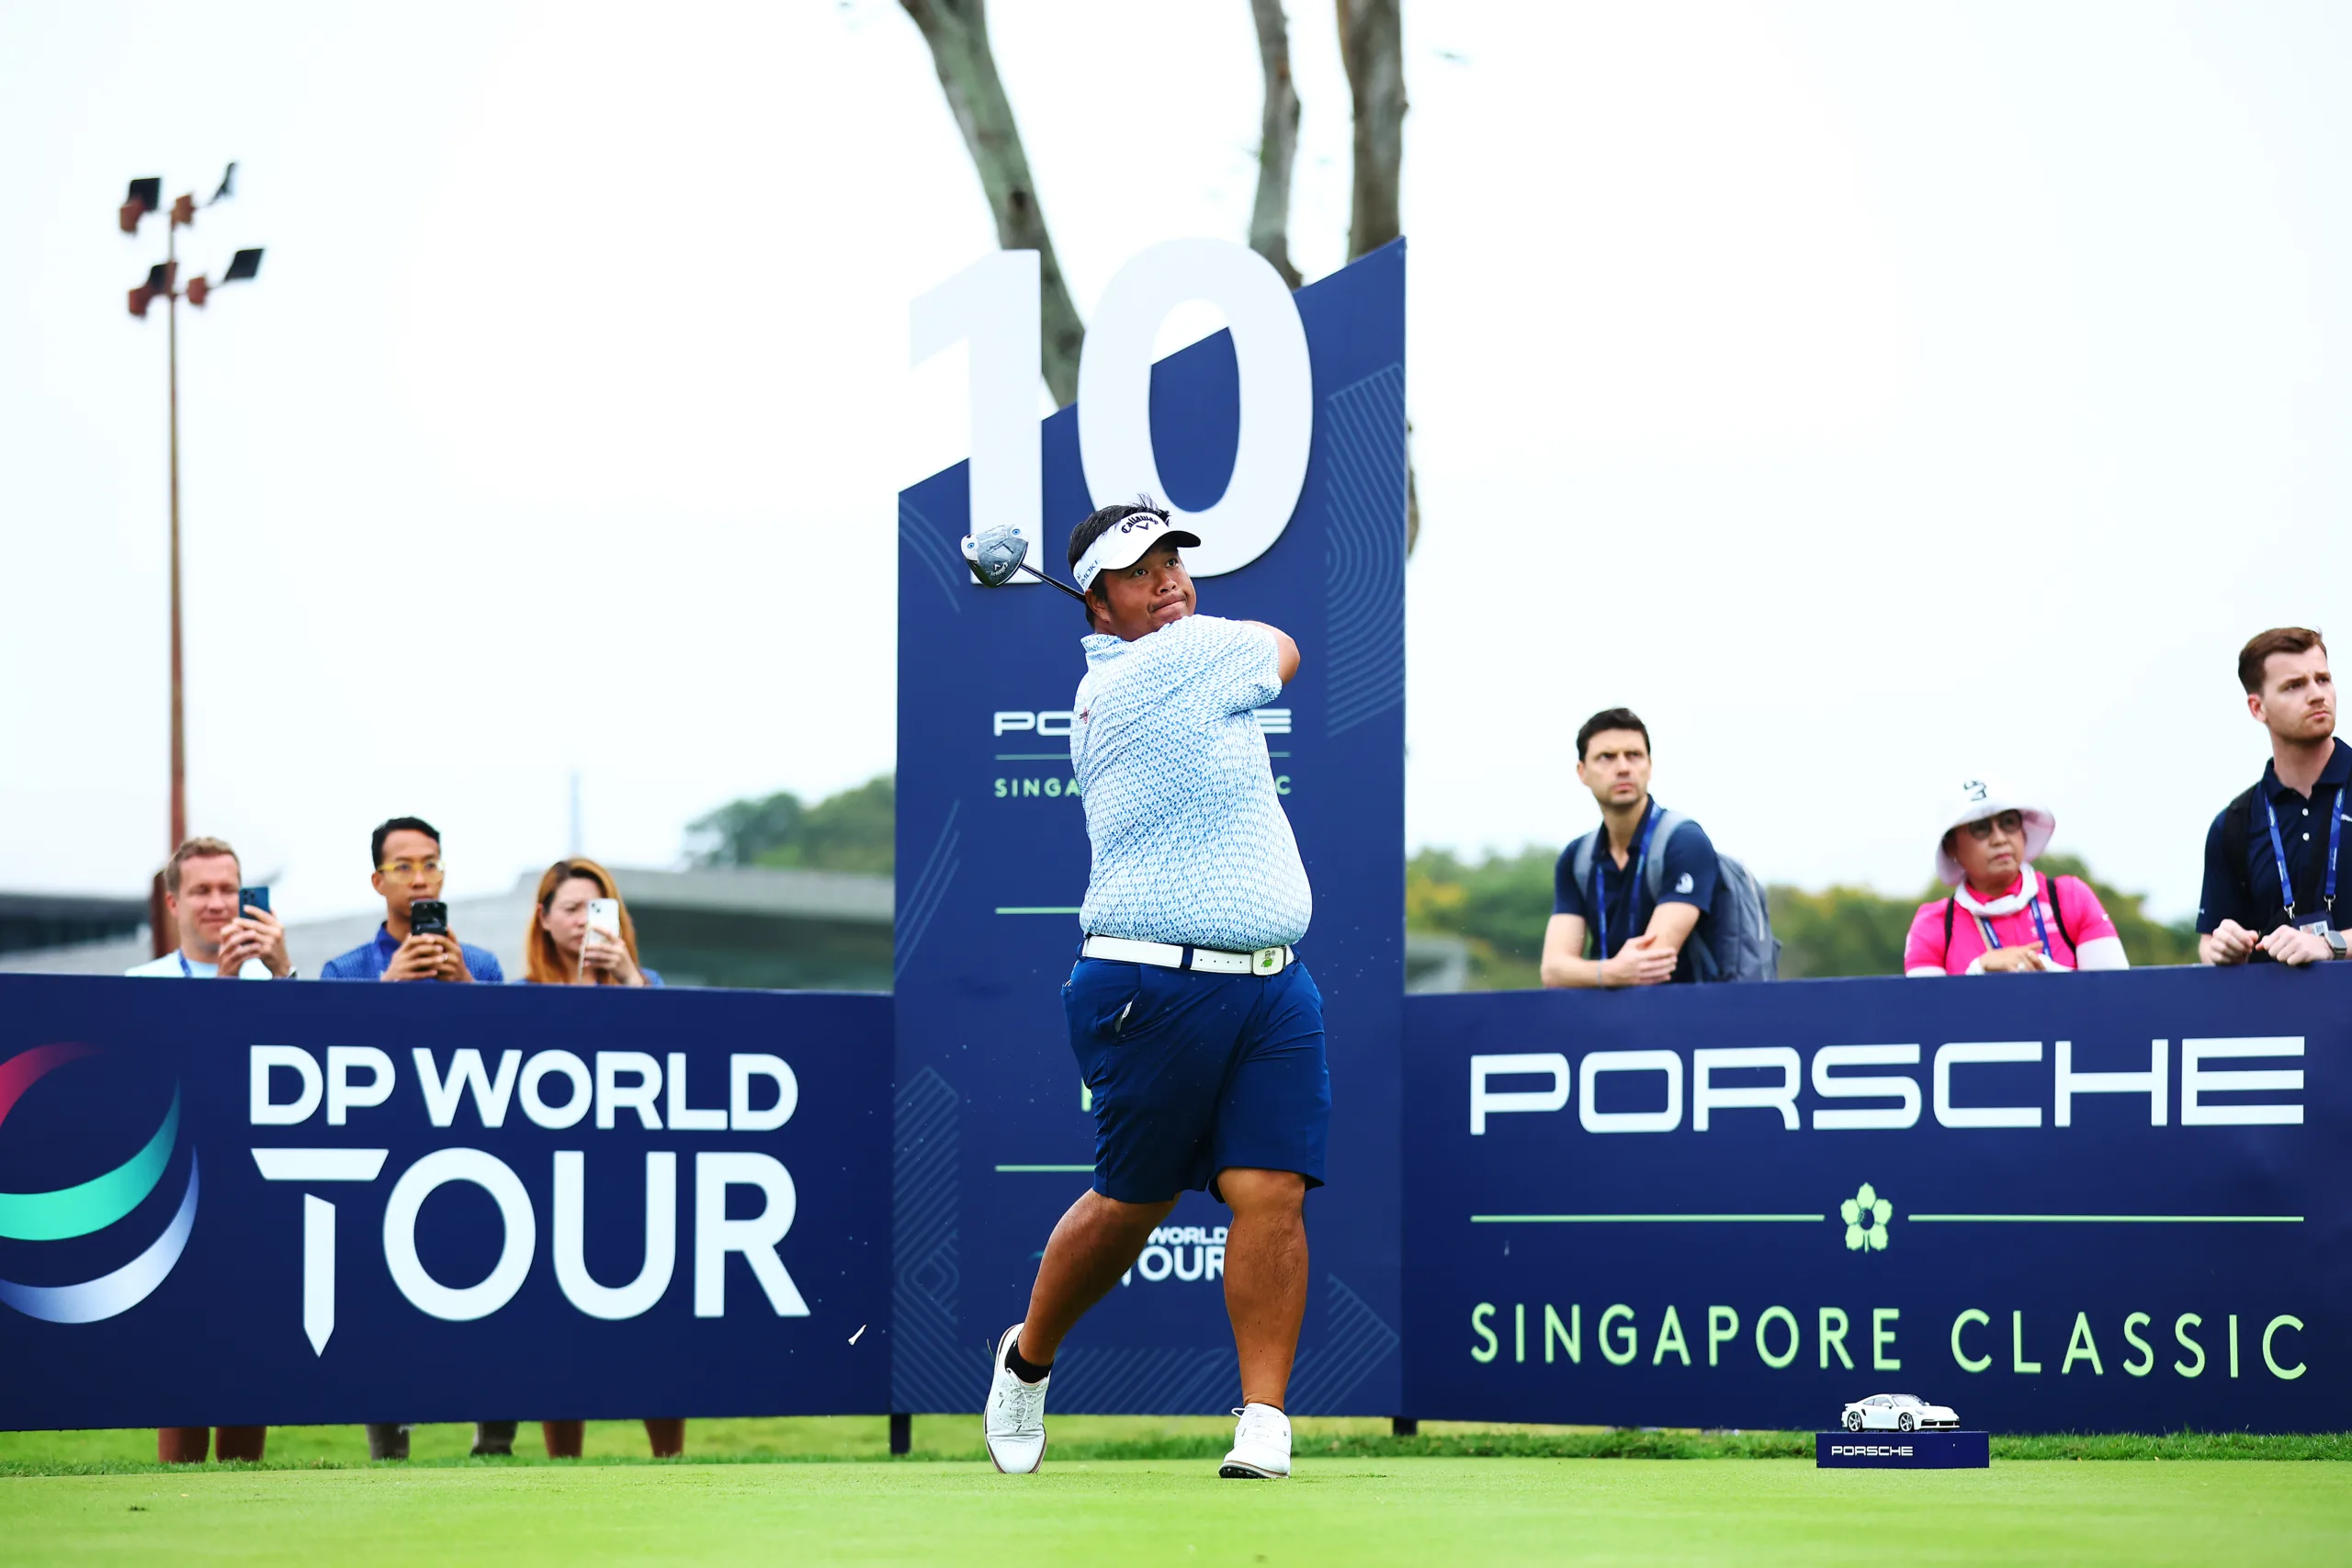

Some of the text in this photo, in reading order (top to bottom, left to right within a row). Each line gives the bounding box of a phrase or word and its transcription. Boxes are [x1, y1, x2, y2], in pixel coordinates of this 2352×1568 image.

[910, 237, 1314, 584] 10
[1121, 514, 1159, 534] Callaway
[249, 1044, 798, 1131] DP WORLD
[1469, 1035, 2305, 1136] PORSCHE
[250, 1147, 811, 1358] TOUR
[1471, 1302, 2307, 1381] SINGAPORE CLASSIC
[1831, 1445, 1914, 1457] PORSCHE
